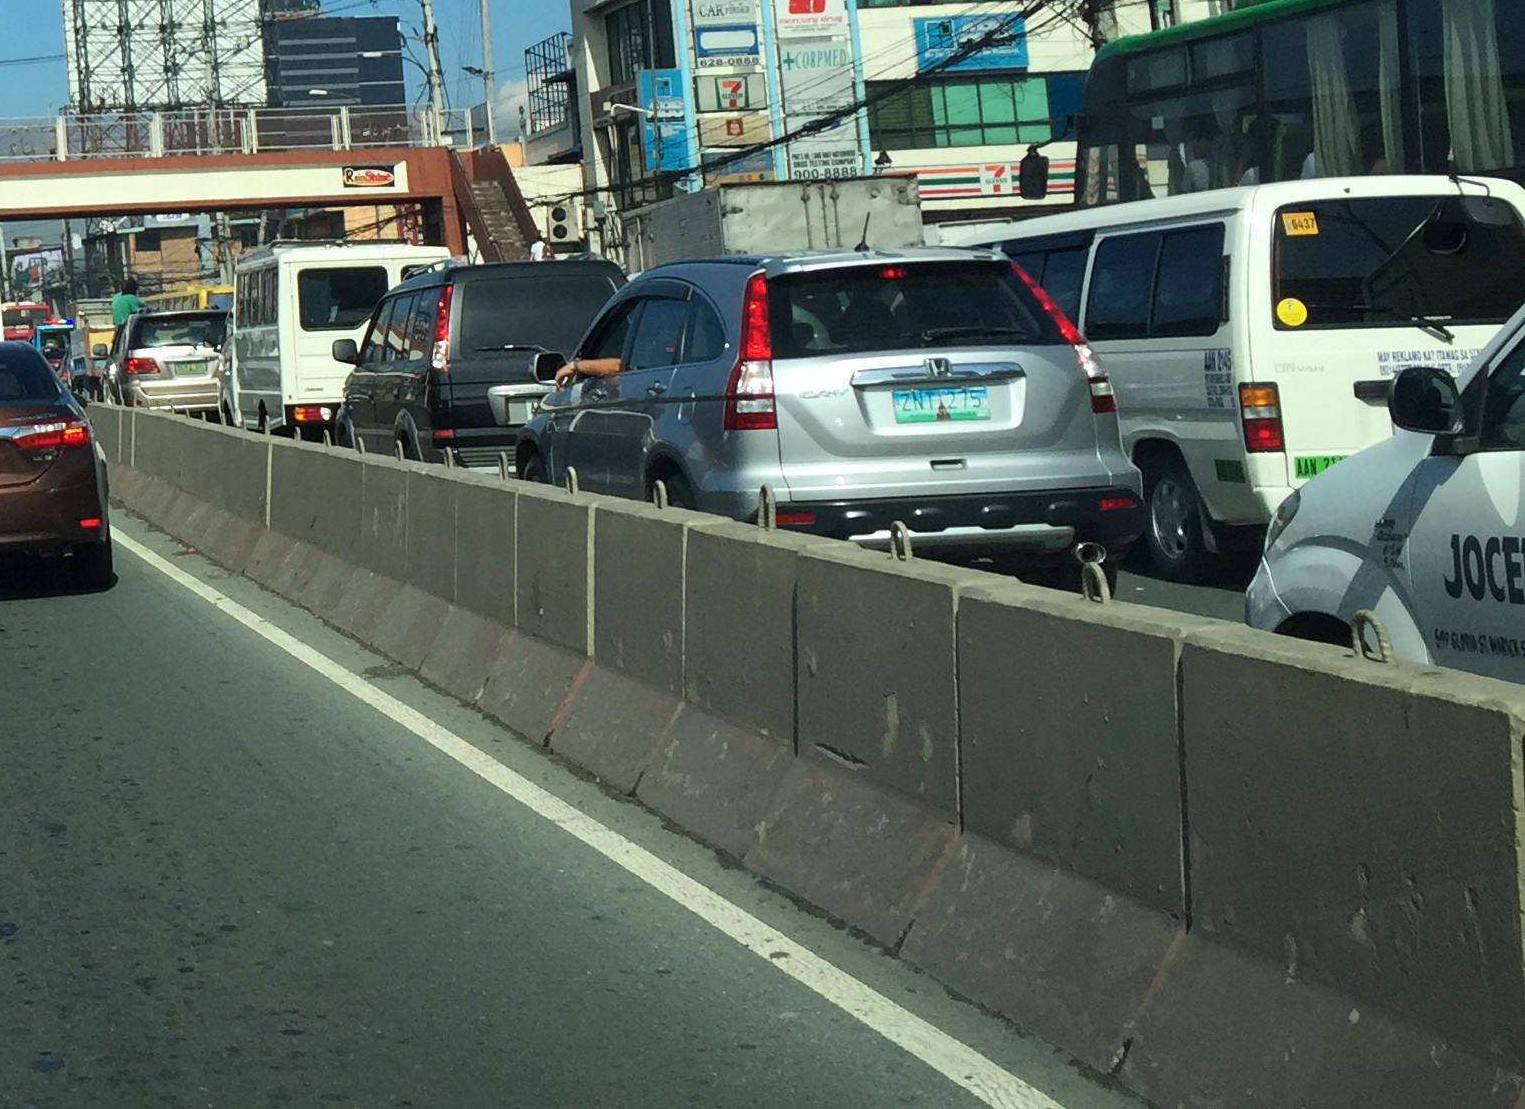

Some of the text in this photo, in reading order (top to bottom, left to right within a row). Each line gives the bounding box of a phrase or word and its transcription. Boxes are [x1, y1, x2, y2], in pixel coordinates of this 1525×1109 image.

[699, 3, 725, 17] CAR
[795, 49, 847, 69] CORPMED
[902, 392, 934, 411] ZNT
[1296, 458, 1317, 477] AAN
[1442, 534, 1525, 605] JOCE
